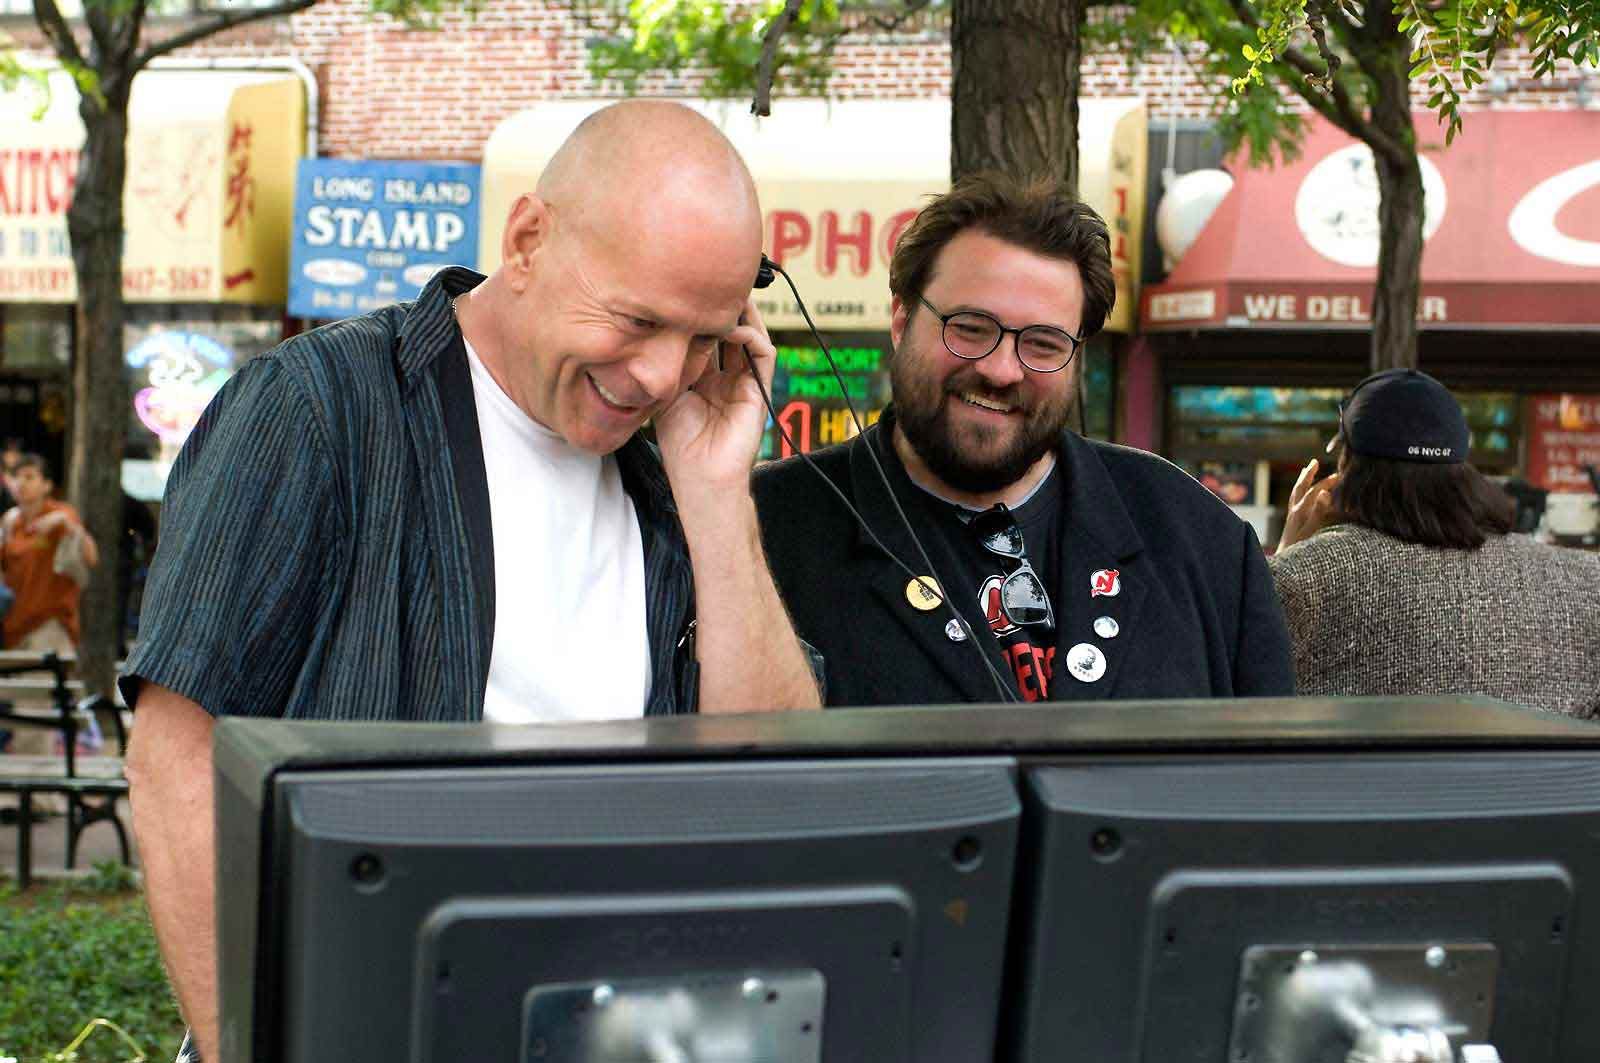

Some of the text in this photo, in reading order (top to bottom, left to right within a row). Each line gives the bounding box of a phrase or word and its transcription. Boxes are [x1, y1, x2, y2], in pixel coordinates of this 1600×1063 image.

[313, 176, 472, 206] LONG ISLAND
[304, 205, 465, 251] STAMP
[1244, 295, 1296, 321] WE
[1306, 295, 1447, 321] DELR
[1421, 447, 1441, 457] NYC
